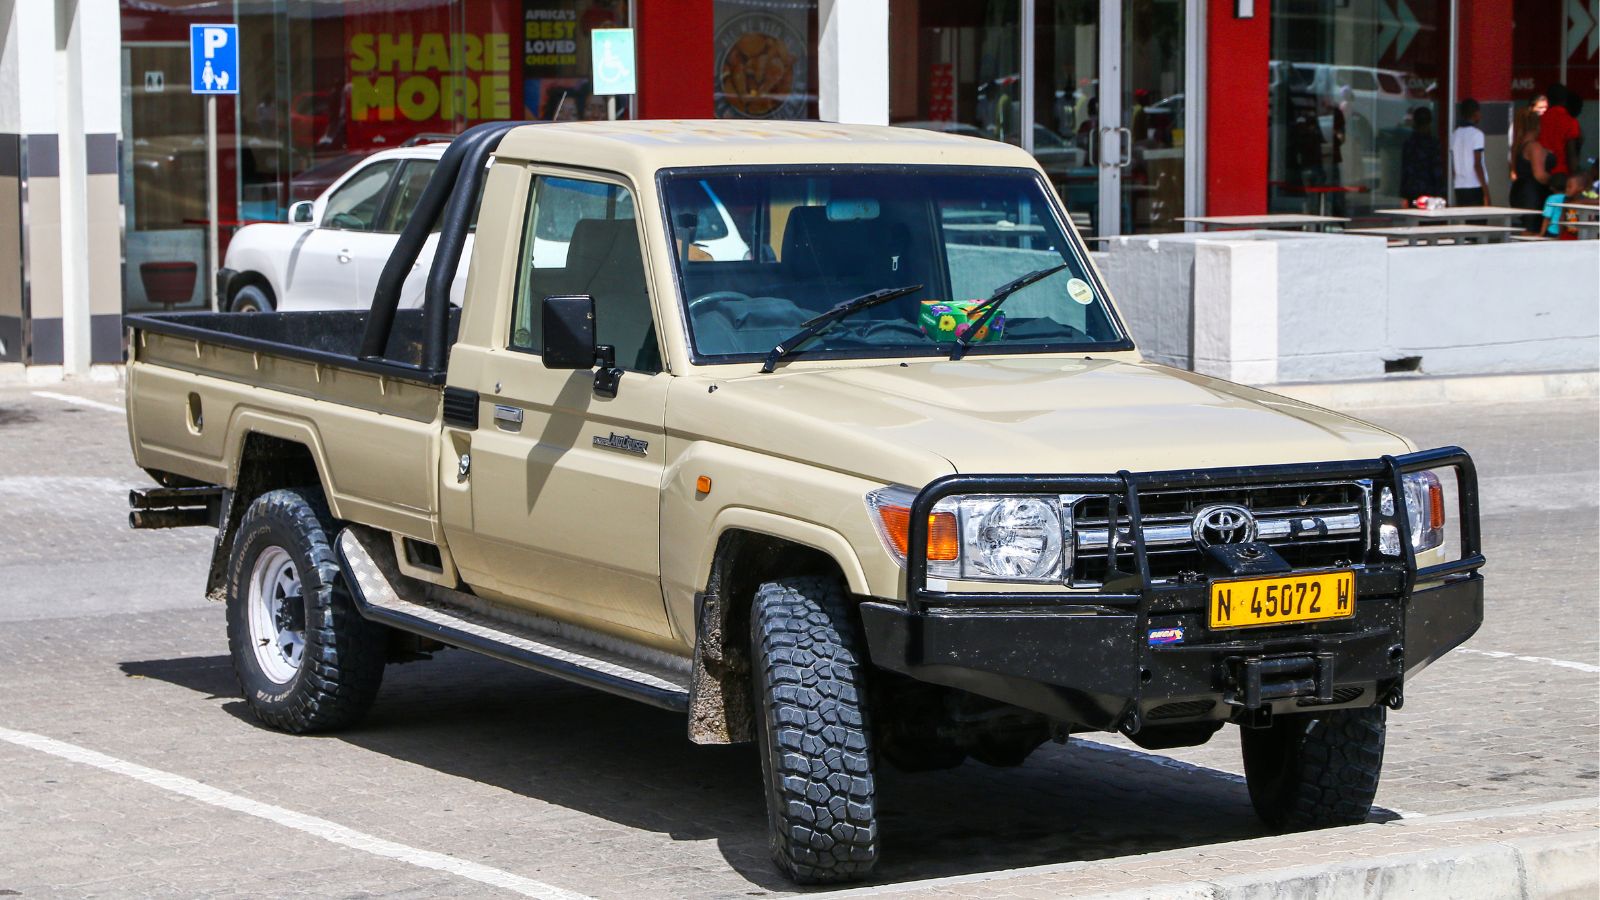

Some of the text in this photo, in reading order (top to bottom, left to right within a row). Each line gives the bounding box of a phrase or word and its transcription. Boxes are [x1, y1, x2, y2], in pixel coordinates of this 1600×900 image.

[526, 9, 576, 20] AFRICA'S
[526, 21, 576, 39] BEST
[204, 28, 228, 58] P
[351, 32, 511, 72] SHARE
[525, 40, 576, 54] LOVED
[525, 54, 576, 65] CHICKEN
[351, 75, 511, 121] MORE
[1217, 578, 1350, 621] N 45072 W
